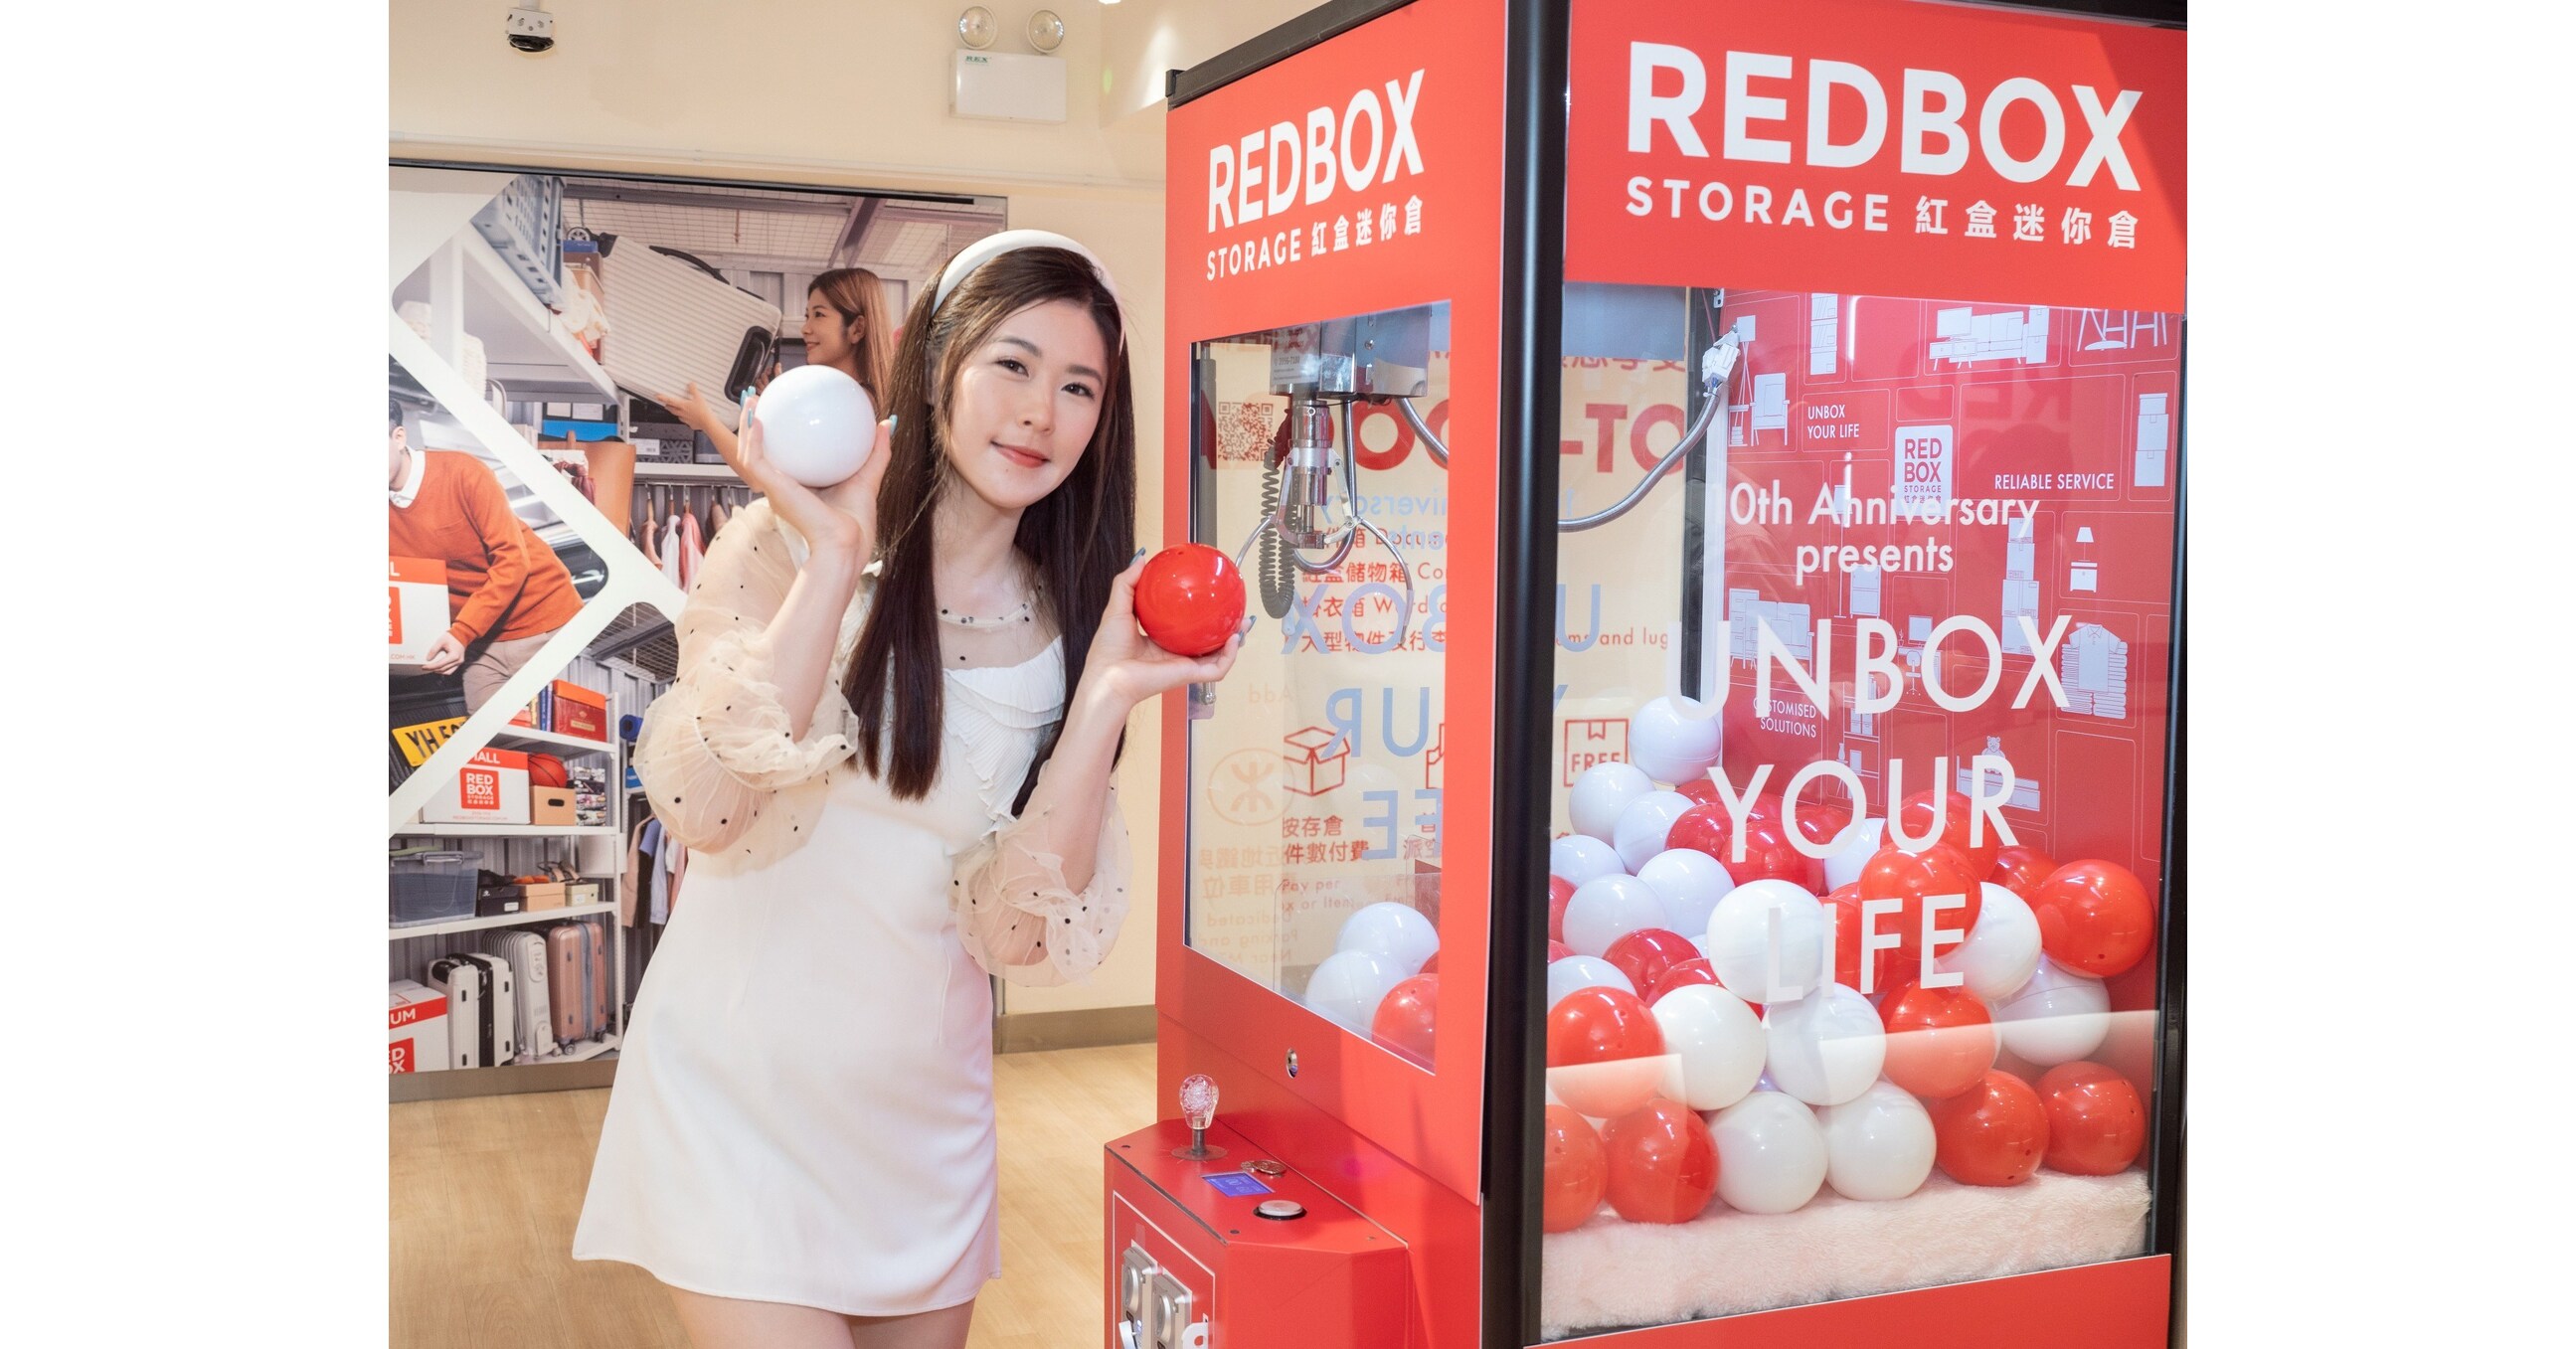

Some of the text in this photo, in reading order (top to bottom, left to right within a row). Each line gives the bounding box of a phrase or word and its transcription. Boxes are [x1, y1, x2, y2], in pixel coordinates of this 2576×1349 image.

[1628, 41, 2143, 191] REDBOX
[1208, 69, 1425, 233] REDBOX
[1626, 176, 2139, 249] STORAGE 紅盒迷你倉
[1207, 195, 1423, 281] STORAGE 紅盒迷你倉
[1807, 405, 1845, 420] UNBOX
[1807, 423, 1859, 439] YOUR LIFE
[1904, 437, 1943, 459] RED
[1904, 461, 1942, 483] BOX
[1994, 473, 2115, 490] RELIABLE SERVICE
[1808, 482, 2040, 538] Anniversary
[1797, 537, 1954, 586] presents
[1600, 628, 1633, 645] and
[1665, 614, 2072, 720] UNBOX
[1761, 717, 1816, 739] SOLUTIONS
[465, 772, 494, 784] RED
[466, 784, 494, 795] BOX
[1707, 756, 2019, 863] YOUR
[1767, 894, 1967, 1003] LIFE
